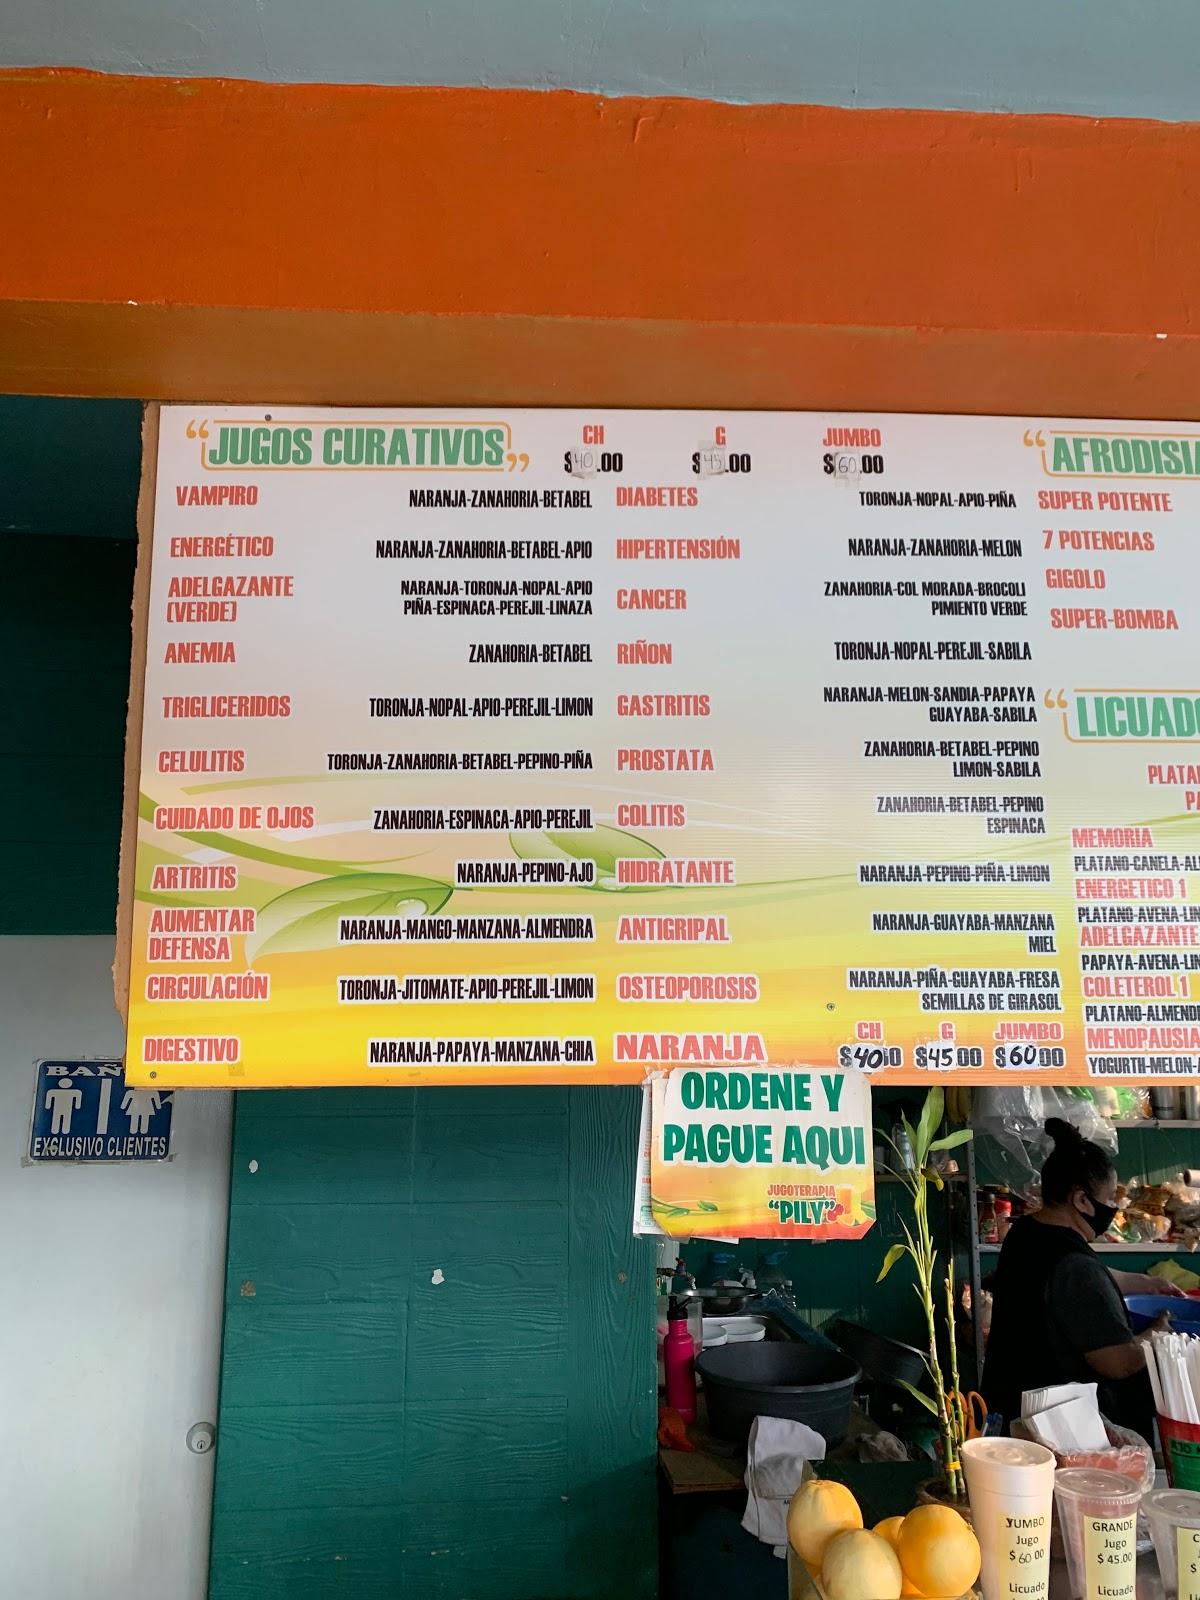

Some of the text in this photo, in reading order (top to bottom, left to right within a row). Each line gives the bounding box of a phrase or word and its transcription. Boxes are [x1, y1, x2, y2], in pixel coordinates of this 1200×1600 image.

[583, 425, 604, 444] CH
[715, 426, 726, 445] G
[822, 428, 881, 447] JUMBO
[176, 485, 258, 506] VAMPIRO
[409, 489, 592, 508] NARANJA-ZANAHORIA-BETABEL
[616, 486, 698, 507] DIABETES
[859, 489, 1016, 508] TORONJA-NOPAL-APIO-PIÑA
[1038, 490, 1173, 512] SUPER POTENTE
[170, 533, 274, 557] ENERGÉTICO
[376, 539, 592, 559] NARANJA-ZANAHORIA-BETABEL-APIO
[616, 536, 740, 560] HIPERTENSIÓN
[848, 538, 1022, 558] NARANJA-ZANAHORIA-MELON
[1043, 530, 1155, 551] 7 POTENCIAS
[168, 575, 294, 597] ADELGAZANTE
[401, 580, 592, 596] NARANJA-TORONJA-NOPAL-APIO
[824, 581, 1026, 597] ZANAHORIA-COL MORADA-BROCOLI
[1045, 569, 1106, 589] GIGOLO
[403, 596, 592, 616] PIÑA-ESPINACA-PEREJIL-LINAZA
[616, 589, 687, 610] CANCER
[931, 601, 1028, 616] PIMIENTO VERDE
[1050, 608, 1179, 629] SUPER-BOMBA
[164, 642, 236, 663] ANEMIA
[469, 644, 592, 663] ZANAHORIA-BETABEL
[617, 639, 672, 664] RIÑON
[834, 641, 1032, 661] TORONJA-NOPAL-PEREJIL-SABILA
[823, 686, 1035, 703] NARANJA-MELON-SANDIA-PAPAYA
[162, 695, 291, 718] TRIGLICERIDOS
[369, 697, 593, 717] TORONJA-NOPAL-APIO-PEREJIL-LIMON
[617, 695, 710, 716] GASTRITIS
[929, 706, 1037, 723] GUAYABA-SABILA
[327, 749, 593, 770] TORONJA-ZANAHORIA-BETABEL-PEPINO-PIÑA
[864, 740, 1040, 758] ZANAHORIA-BETABEL-PEPINO
[158, 750, 245, 773] CELULITIS
[617, 749, 714, 771] PROSTATA
[953, 760, 1041, 778] LIMON-SABILA
[617, 804, 685, 827] COLITIS
[877, 796, 1044, 814] ZANAHORIA-BETABEL-PEPINO
[155, 806, 314, 830] CUIDADO DE OJOS
[373, 808, 594, 830] ZANAHORIA-ESPINACA-APIO-PEREJIL
[987, 816, 1046, 834] ESPINACA
[1072, 827, 1153, 848] MEMORIA
[152, 866, 237, 890] ARTRITIS
[457, 862, 594, 883] NARANJA-PEPINO-AJO
[618, 860, 734, 884] HIDRATANTE
[860, 862, 1050, 883] NARANJA-PEPINO-PIÑA-LIMON
[1076, 878, 1186, 899] ENERGETICO 1
[150, 909, 255, 932] AUMENTAR
[340, 918, 594, 940] NARANJA-MANGO-MANZANA-ALMENDRA
[619, 918, 729, 941] ANTIGRIPAL
[872, 913, 1055, 931] NARANJA-GUAYABA-MANZANA
[1028, 936, 1057, 953] MIEL
[1081, 925, 1199, 946] ADELGAZANTE
[148, 938, 230, 961] DEFENSA
[147, 972, 268, 1000] CIRCULACIÓN
[619, 976, 757, 1000] OSTEOPOROSIS
[849, 967, 1059, 989] NARANJA-PIÑA-GUAYABA-FRESA
[1084, 976, 1188, 997] COLETEROL 1
[339, 978, 594, 1000] TORONJA-JITOMATE-APIO-PEREJIL-LIMON
[922, 993, 1062, 1011] SEMILLAS DE GIRASOL
[1085, 1005, 1200, 1022] PLATANO-ALMEND
[857, 1022, 882, 1039] CH
[941, 1023, 953, 1039] G
[994, 1023, 1062, 1040] JUMBO
[144, 1038, 238, 1062] DIGESTIVO
[370, 1040, 594, 1063] NARANJA-PAPAYA-MANZANA-CHIA
[616, 1034, 765, 1061] NARANJA
[1089, 1056, 1200, 1074] YOGURTH-MELON-
[681, 1072, 844, 1112] ORDENE Y
[33, 1136, 166, 1157] EXCLUSIVO CLIENTES
[664, 1123, 865, 1171] PAGUE AQUI
[767, 1184, 836, 1197] JUGOTERAPIA
[1006, 1517, 1044, 1529] YUMBO
[1092, 1520, 1133, 1532] GRANDE
[1016, 1535, 1038, 1547] Jugo
[1104, 1539, 1127, 1551] Jugo
[1009, 1582, 1045, 1594] Licuado
[1097, 1585, 1134, 1597] Licuado
